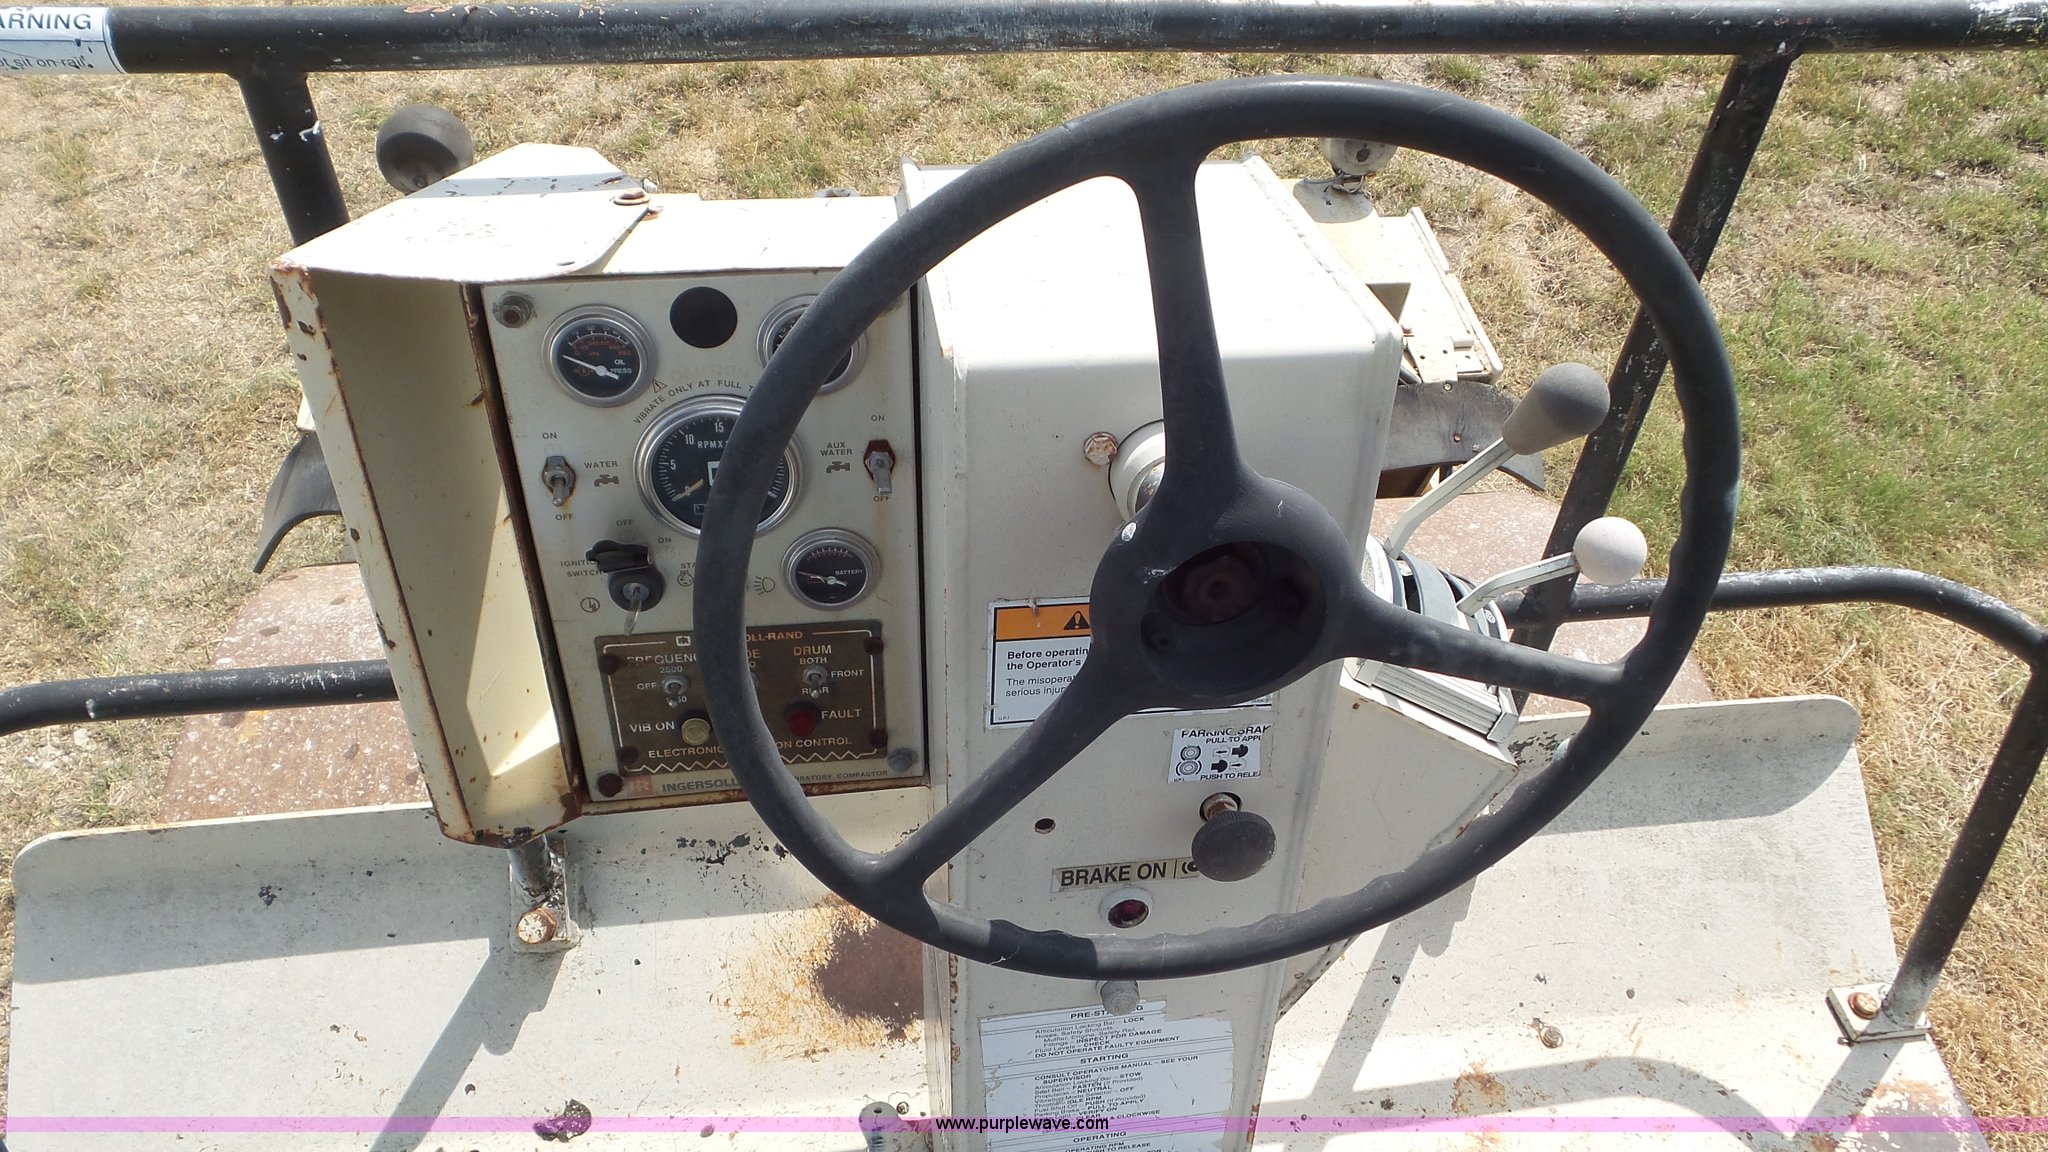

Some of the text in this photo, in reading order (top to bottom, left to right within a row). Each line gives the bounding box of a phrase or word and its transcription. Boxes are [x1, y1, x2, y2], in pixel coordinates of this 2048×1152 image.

[36, 58, 57, 67] on
[632, 394, 666, 424] VIBRATE
[667, 381, 694, 397] ONLY
[697, 380, 711, 389] AT
[717, 379, 742, 390] FULL
[870, 414, 886, 422] ON
[714, 421, 724, 433] 15
[541, 431, 558, 440] ON
[684, 433, 695, 445] 10
[826, 441, 846, 449] AUX
[820, 448, 853, 457] WATER
[584, 460, 618, 469] WATER
[670, 459, 677, 470] 5
[555, 513, 574, 521] OFF
[657, 536, 672, 544] ON
[835, 568, 864, 576] BATTERY
[793, 644, 832, 656] DRUM
[1007, 650, 1042, 660] Before
[799, 656, 827, 665] BOTH
[1006, 658, 1081, 671] the Operator's
[660, 665, 683, 674] 2500
[830, 669, 865, 678] FRONT
[637, 682, 658, 690] OFF
[1006, 677, 1025, 687] The
[1005, 687, 1041, 697] serious
[821, 708, 862, 720] FAULT
[629, 720, 676, 733] VIB ON
[795, 737, 852, 748] CONTROL
[648, 745, 724, 759] ELECTRONIC
[837, 769, 888, 779] COMPACTOR
[1200, 772, 1223, 781] PUSH
[662, 777, 739, 793] INGERSOLL
[1060, 862, 1167, 887] BRAKE ON
[1123, 1016, 1145, 1024] LOCK
[1076, 1036, 1108, 1044] INSPECT
[1129, 1029, 1162, 1038] DAMAGE
[1066, 1046, 1101, 1055] OPERATE
[1104, 1041, 1134, 1050] FAULTY
[1135, 1036, 1180, 1046] EQUIPMENT
[1083, 1040, 1110, 1048] CHECK
[1080, 1052, 1129, 1065] STARTING
[1035, 1072, 1070, 1081] CONSULT
[1072, 1066, 1119, 1076] OPERATORS
[1121, 1061, 1153, 1069] MANUAL
[1120, 1071, 1142, 1079] STOW
[1043, 1074, 1091, 1085] SUPERVISOR
[1072, 1082, 1102, 1090] FASTEN
[1077, 1085, 1112, 1094] NEUTRAL
[1120, 1098, 1144, 1106] APPLY
[1116, 1109, 1160, 1119] CLOCKWISE
[1073, 1131, 1127, 1143] OPERATING
[1118, 1142, 1151, 1151] RELEASE
